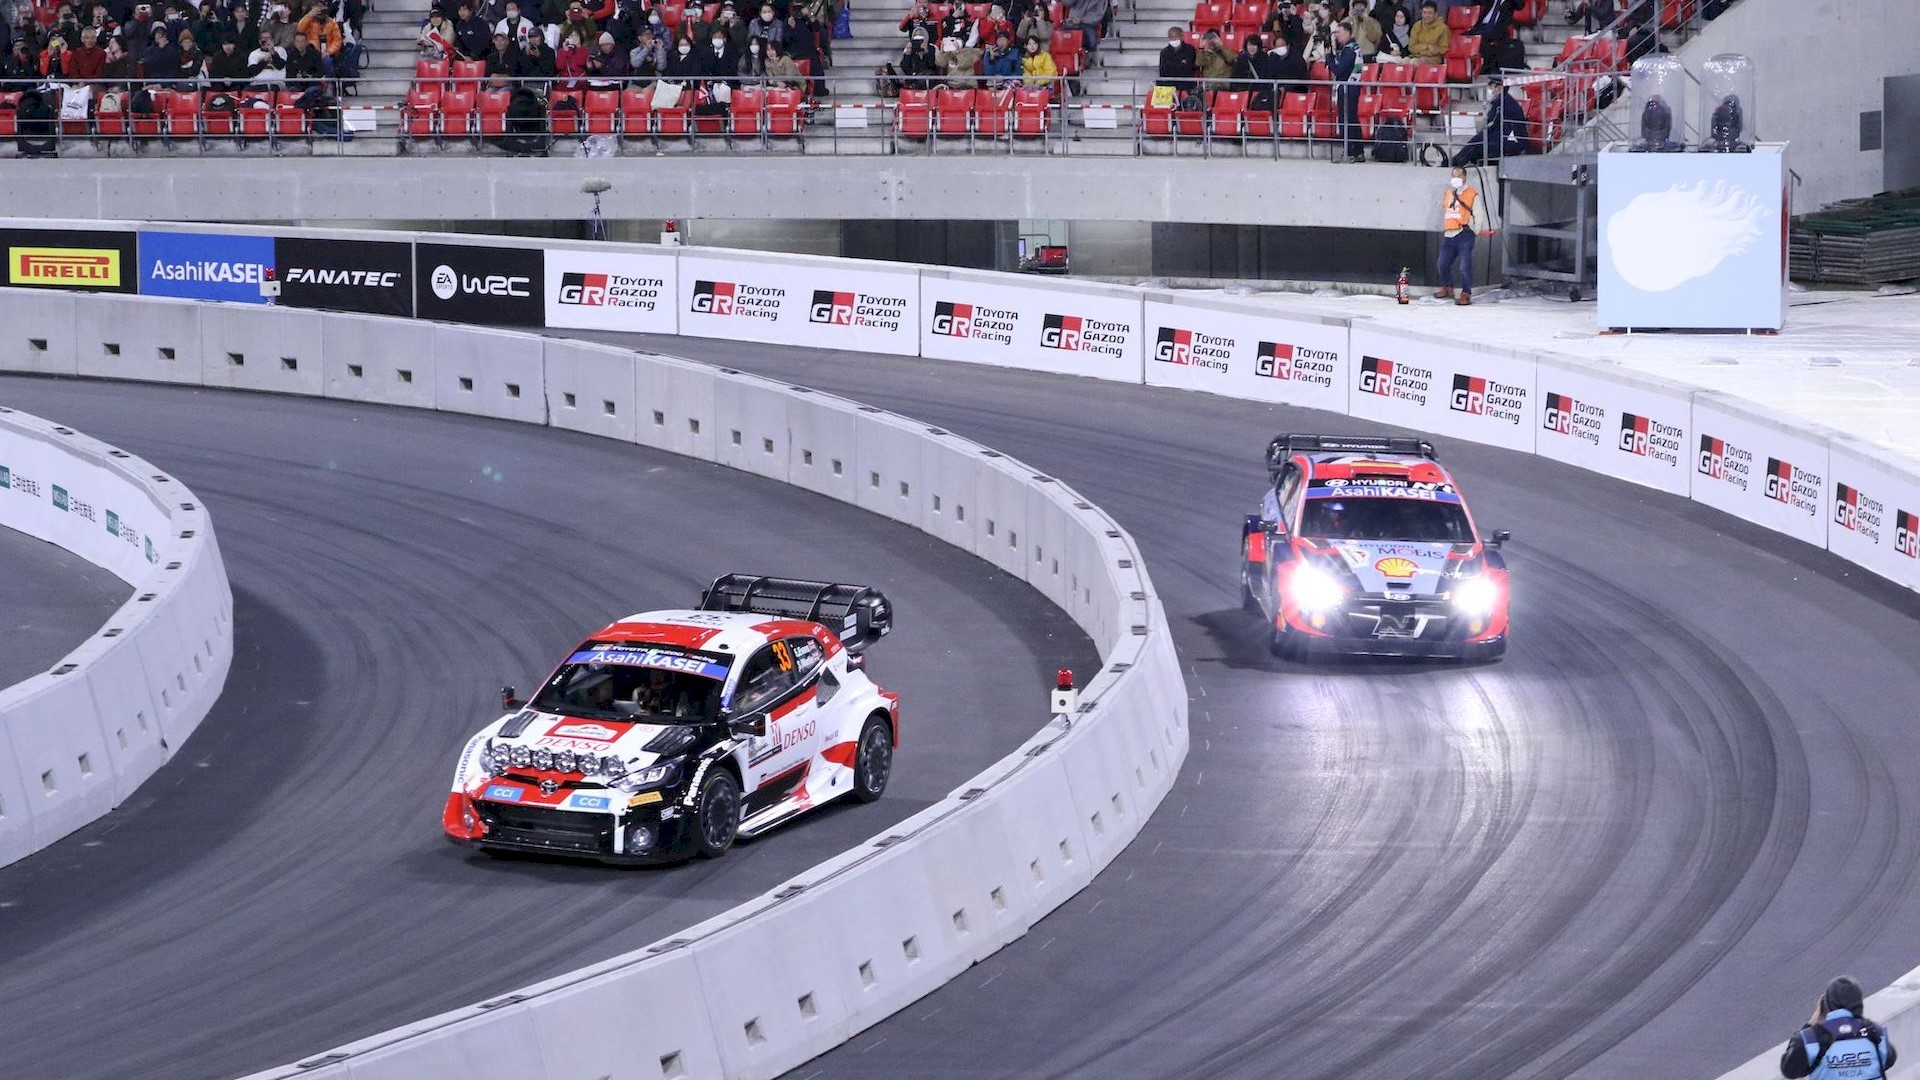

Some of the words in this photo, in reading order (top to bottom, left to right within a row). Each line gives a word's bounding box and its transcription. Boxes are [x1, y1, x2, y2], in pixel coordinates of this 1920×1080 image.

[20, 254, 110, 278] PIRELLI
[152, 260, 264, 284] AsahiKASEI
[286, 268, 397, 286] FANATEC
[436, 273, 452, 284] EA
[462, 274, 530, 296] WRC
[612, 276, 663, 287] TOYOTA
[559, 285, 605, 305] GR
[609, 286, 657, 298] GAZOO
[739, 285, 785, 296] TOYOTA
[608, 298, 655, 311] Racing
[692, 293, 733, 314] GR
[737, 296, 780, 308] GAZOO
[858, 294, 906, 306] TOYOTA
[736, 306, 778, 321] Racing
[810, 303, 852, 324] GR
[856, 306, 900, 318] GAZOO
[976, 306, 1018, 320] TOYOTA
[854, 317, 898, 331] Racing
[933, 315, 970, 336] GR
[974, 318, 1014, 331] GAZOO
[1086, 319, 1130, 333] TOYOTA
[972, 330, 1011, 345] Racing
[1042, 327, 1080, 350] GR
[1084, 332, 1124, 344] GAZOO
[1195, 332, 1234, 347] TOYOTA
[1082, 342, 1122, 358] Racing
[1156, 341, 1190, 364] GR
[1194, 345, 1230, 358] GAZOO
[1296, 347, 1338, 361] TOYOTA
[1192, 356, 1228, 373] Racing
[1256, 356, 1290, 379] GR
[1294, 359, 1333, 373] GAZOO
[1396, 363, 1432, 379] TOYOTA
[1294, 370, 1331, 387] Racing
[1360, 370, 1390, 396] GR
[1394, 376, 1428, 390] GAZOO
[1393, 388, 1426, 406] Racing
[1488, 380, 1526, 398] TOYOTA
[1451, 389, 1484, 414] GR
[1487, 394, 1521, 410] GAZOO
[1574, 400, 1604, 418] TOYOTA
[1485, 406, 1520, 424] Racing
[1545, 408, 1570, 434] GR
[1573, 414, 1600, 429] GAZOO
[1572, 426, 1599, 446] Racing
[1651, 420, 1682, 438] TOYOTA
[1620, 428, 1648, 456] GR
[1650, 434, 1678, 451] GAZOO
[1648, 446, 1676, 466] Racing
[1726, 443, 1752, 462] TOYOTA
[1699, 450, 1722, 479] GR
[1724, 457, 1748, 474] GAZOO
[1722, 470, 1748, 490] Racing
[1794, 467, 1822, 486] TOYOTA
[1331, 486, 1436, 500] AsahiKASEI
[1766, 474, 1790, 503] GR
[1792, 481, 1817, 499] GAZOO
[1790, 494, 1816, 516] Racing
[1859, 493, 1884, 514] TOYOTA
[1835, 500, 1856, 530] GR
[1857, 508, 1880, 526] GAZOO
[1856, 522, 1879, 544] Racing
[1896, 526, 1917, 558] GR
[589, 651, 707, 673] AsahiKASEI
[772, 642, 792, 672] 33
[784, 720, 816, 750] DENSO
[535, 738, 612, 751] DENSO
[683, 757, 714, 806] Panasonic
[493, 788, 513, 798] CCI
[578, 797, 600, 807] CCI
[1826, 1051, 1872, 1064] WRC
